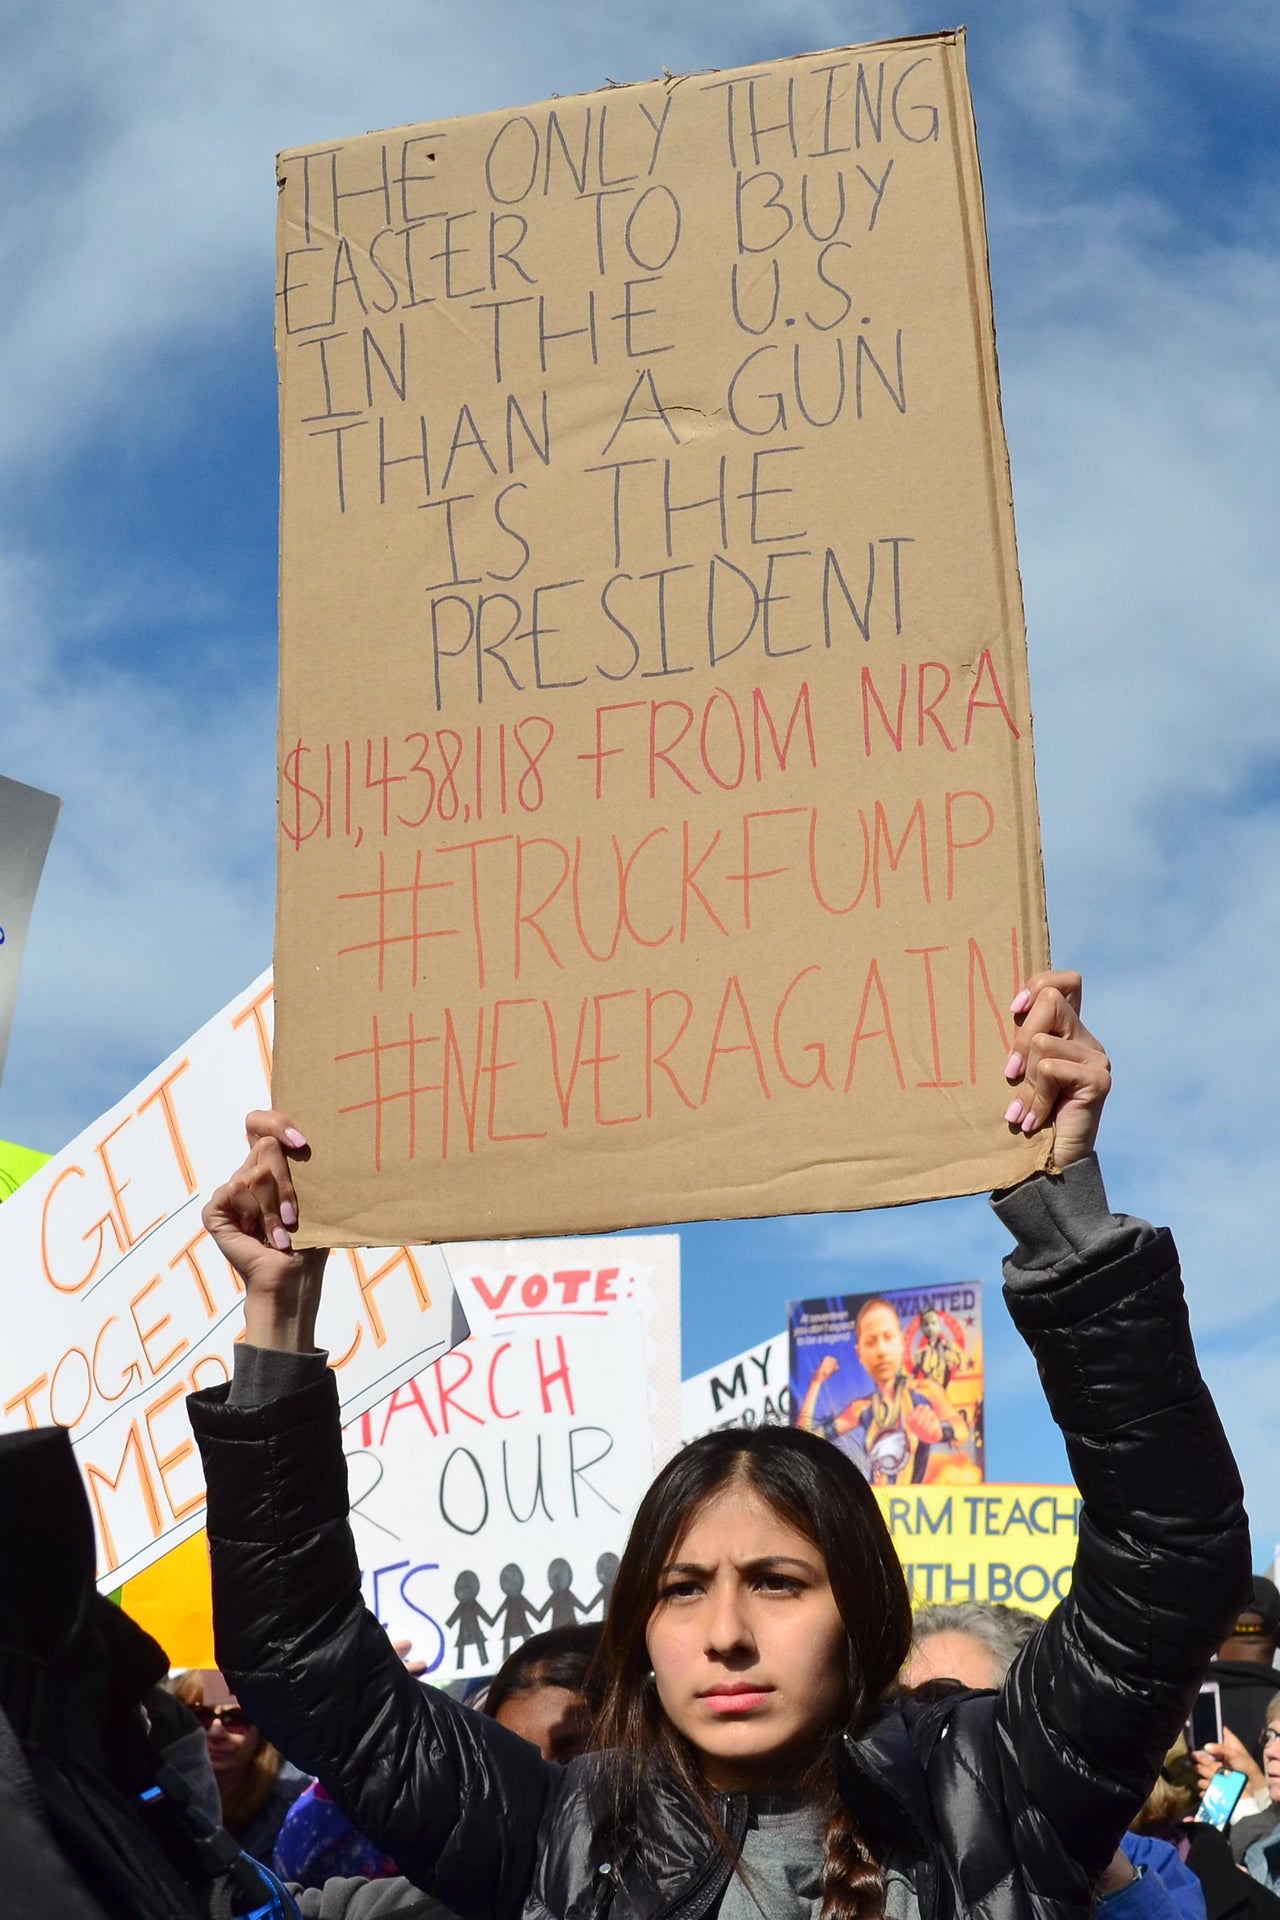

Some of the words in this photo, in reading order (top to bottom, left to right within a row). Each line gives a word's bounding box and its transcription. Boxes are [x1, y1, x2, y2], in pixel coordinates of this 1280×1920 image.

[283, 133, 447, 243] THE
[485, 96, 673, 204] ONLY
[701, 57, 940, 168] THING
[275, 209, 538, 335] EASIER
[575, 185, 682, 275] TO
[737, 159, 894, 254] BUY
[299, 322, 407, 422] IN
[470, 276, 675, 383] THE
[732, 242, 871, 335] U.S.
[308, 390, 550, 513] THAN
[601, 369, 680, 456] A
[728, 328, 907, 436] GUN
[418, 482, 531, 590] IS
[584, 446, 807, 568] THE
[429, 538, 915, 711] PRESIDENT
[280, 715, 555, 851] $11,438,118
[577, 682, 817, 800] FROM
[861, 649, 1021, 757] NRA
[337, 789, 995, 993] #TRUCKFUMP
[334, 927, 1020, 1173] #NEVERAGAIN
[41, 1057, 198, 1295] GET
[3, 1225, 246, 1432] TOGET
[471, 1267, 634, 1310] VOTE:
[710, 1345, 772, 1413] MY
[440, 1426, 621, 1536] OUR
[964, 1496, 1086, 1536] TEACH
[901, 1562, 976, 1604] ITH
